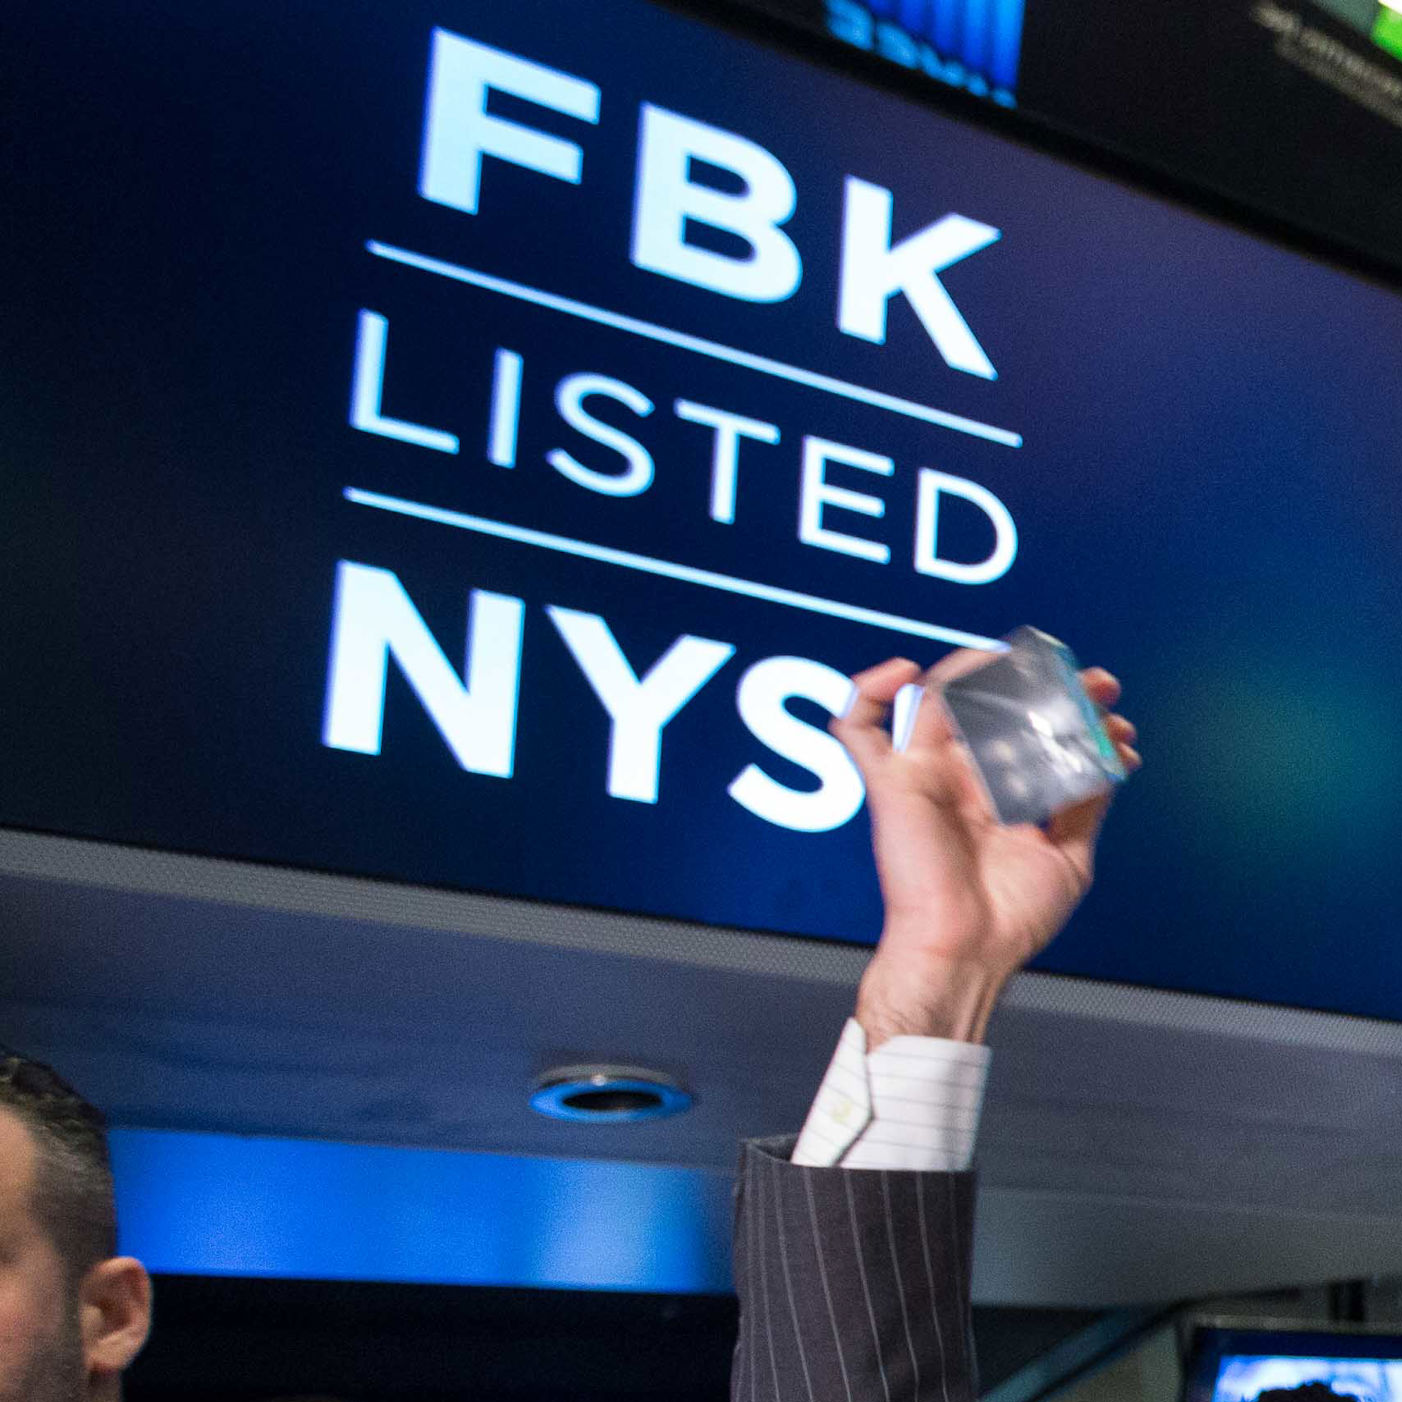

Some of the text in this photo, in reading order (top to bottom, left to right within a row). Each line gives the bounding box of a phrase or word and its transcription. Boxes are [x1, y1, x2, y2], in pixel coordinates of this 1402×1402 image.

[418, 26, 1000, 381] FBK
[350, 308, 1020, 585] LISTED
[322, 560, 925, 834] NYS
